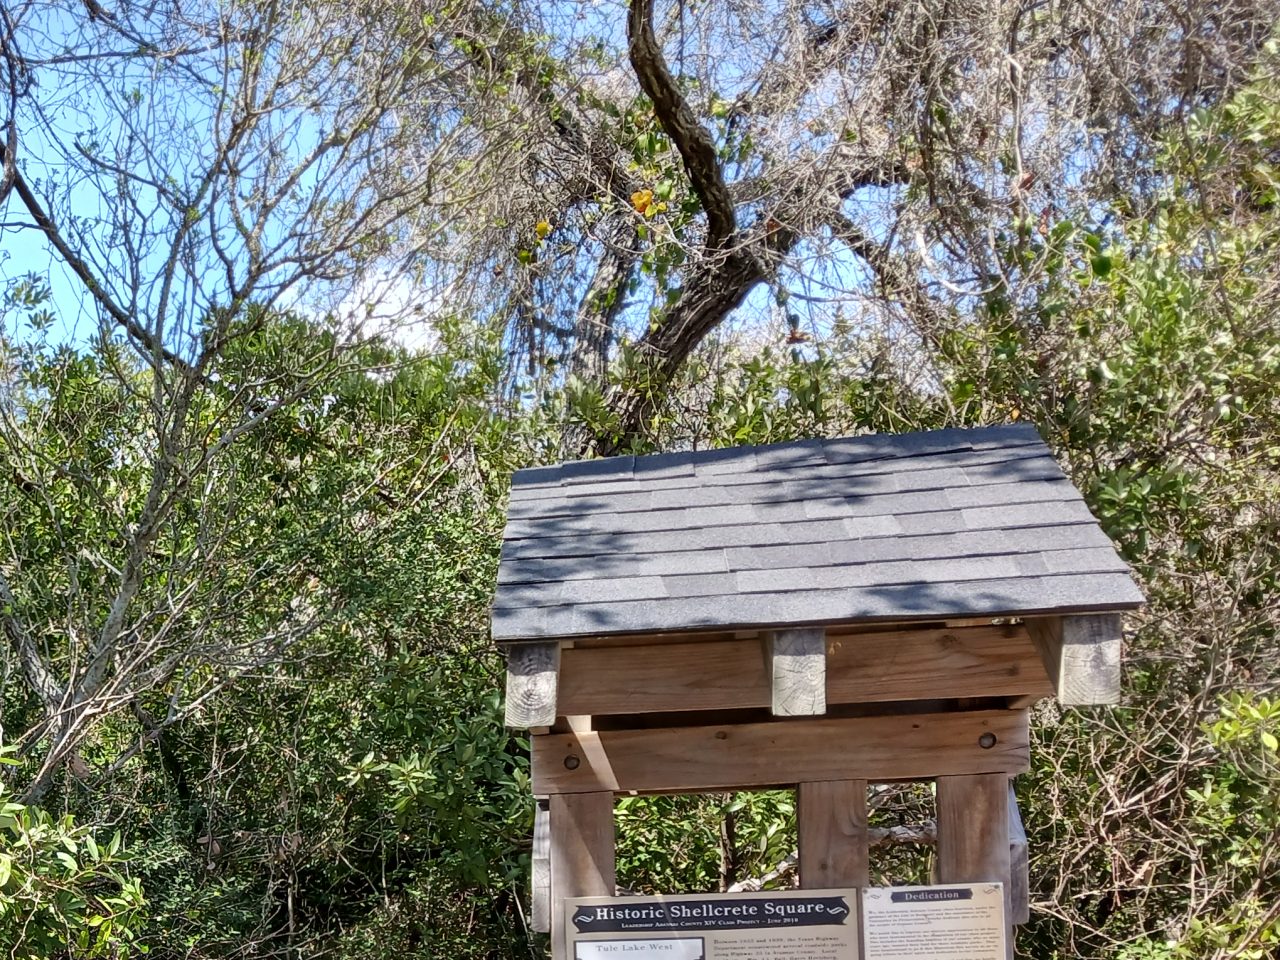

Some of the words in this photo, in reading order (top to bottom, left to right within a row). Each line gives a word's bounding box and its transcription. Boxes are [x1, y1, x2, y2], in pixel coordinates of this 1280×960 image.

[905, 892, 959, 900] Dedication
[596, 907, 664, 920] Historic
[670, 904, 758, 918] Shellcrete
[764, 903, 825, 917] Square
[649, 943, 673, 951] West
